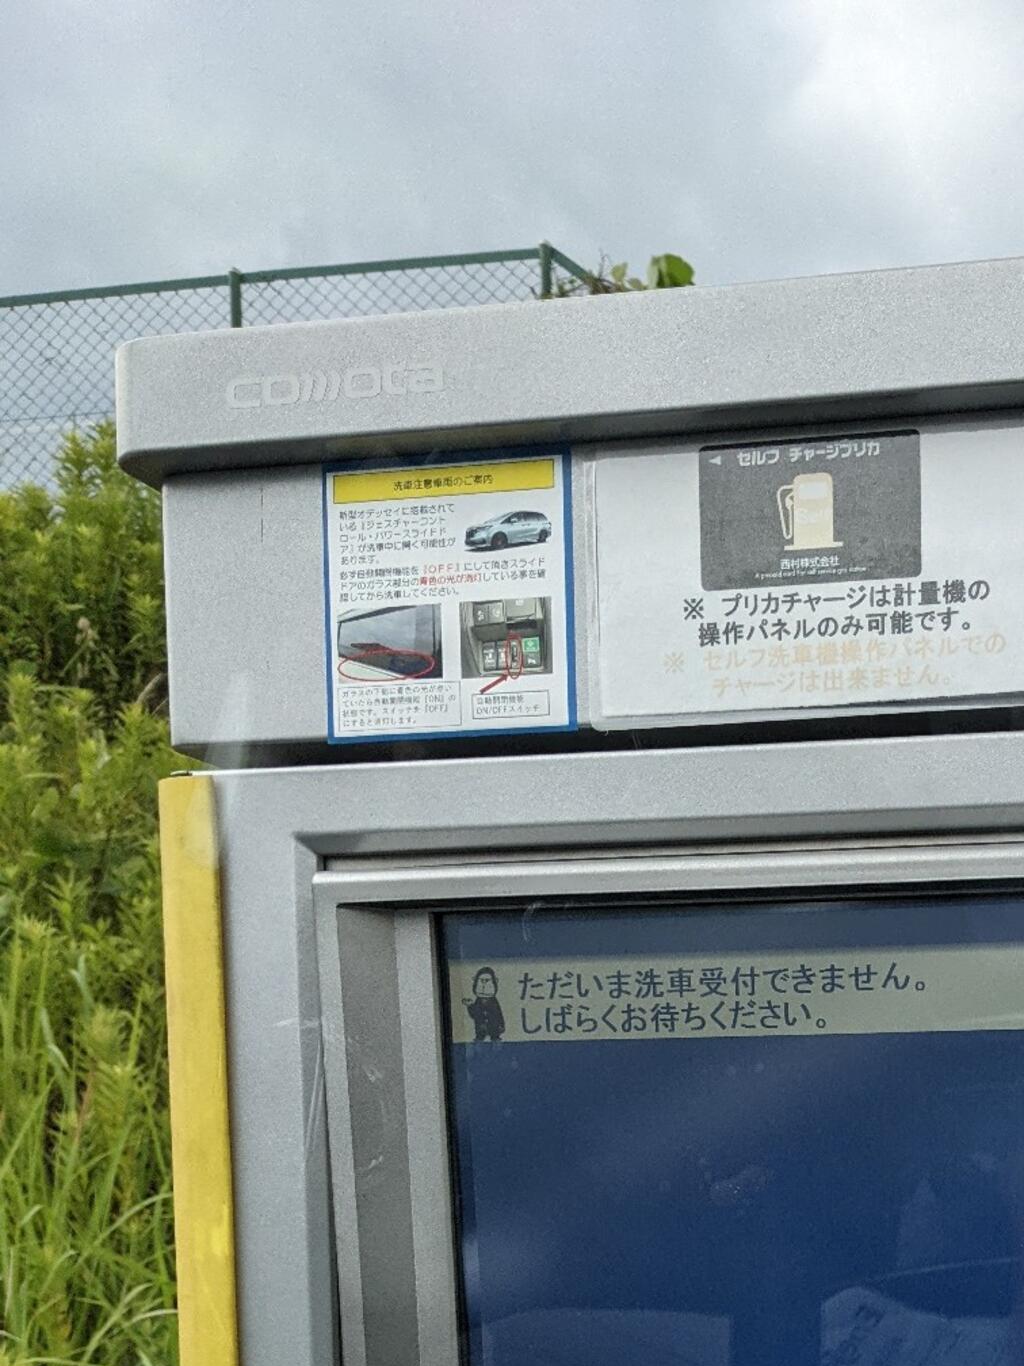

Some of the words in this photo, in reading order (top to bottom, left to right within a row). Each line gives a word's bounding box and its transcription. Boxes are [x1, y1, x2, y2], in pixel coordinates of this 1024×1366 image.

[737, 448, 780, 466] セルフ
[788, 441, 881, 463] チャージプリカ
[721, 578, 991, 618] プリカチャージは計量機の
[698, 608, 972, 648] 操作パネルのみ可能です。
[703, 635, 1007, 672] セルフ洗車機操作パネルでの
[712, 664, 954, 698] チャージは出来ません。
[518, 962, 927, 1001] ただいま洗車受付できません。
[520, 1001, 828, 1034] しばらくお待ちください。
